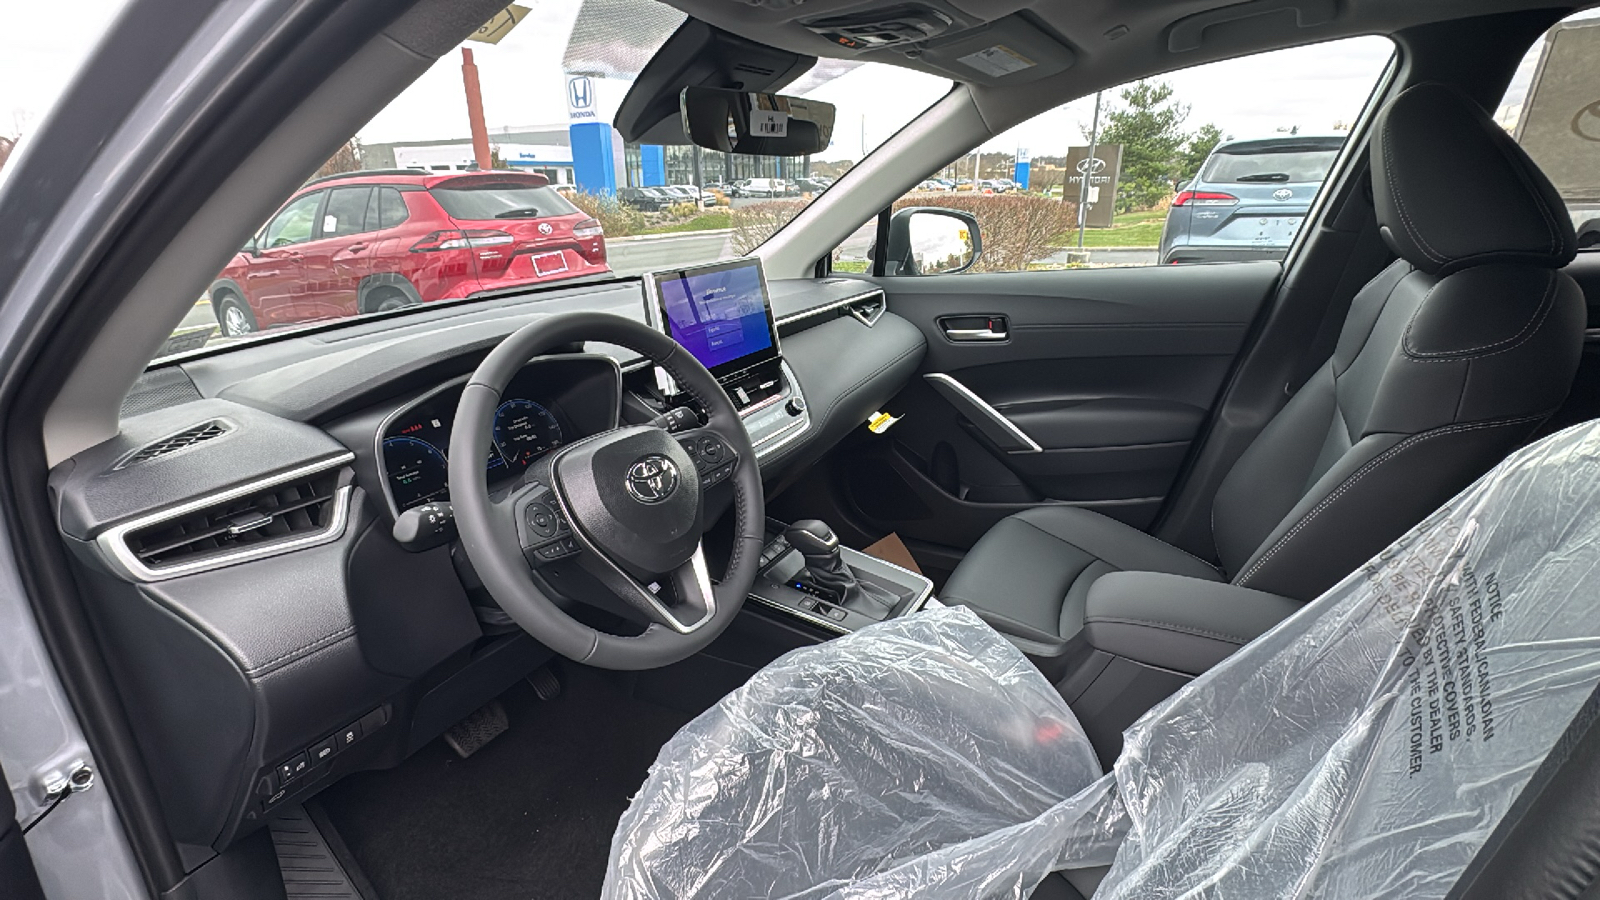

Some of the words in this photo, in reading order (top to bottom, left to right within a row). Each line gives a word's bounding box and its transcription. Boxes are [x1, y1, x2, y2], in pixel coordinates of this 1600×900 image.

[570, 111, 596, 119] HONDA
[1069, 176, 1111, 184] HYNDAI
[1485, 572, 1503, 622] NOTICE
[1449, 596, 1466, 648] SAFETY
[1401, 648, 1414, 667] TO
[1424, 645, 1436, 666] BY
[1408, 668, 1420, 696] THE
[1426, 668, 1438, 694] THE
[1429, 694, 1442, 754] DEALER
[1442, 682, 1460, 740] COVERS
[1410, 696, 1423, 779] CUSTOMER.
